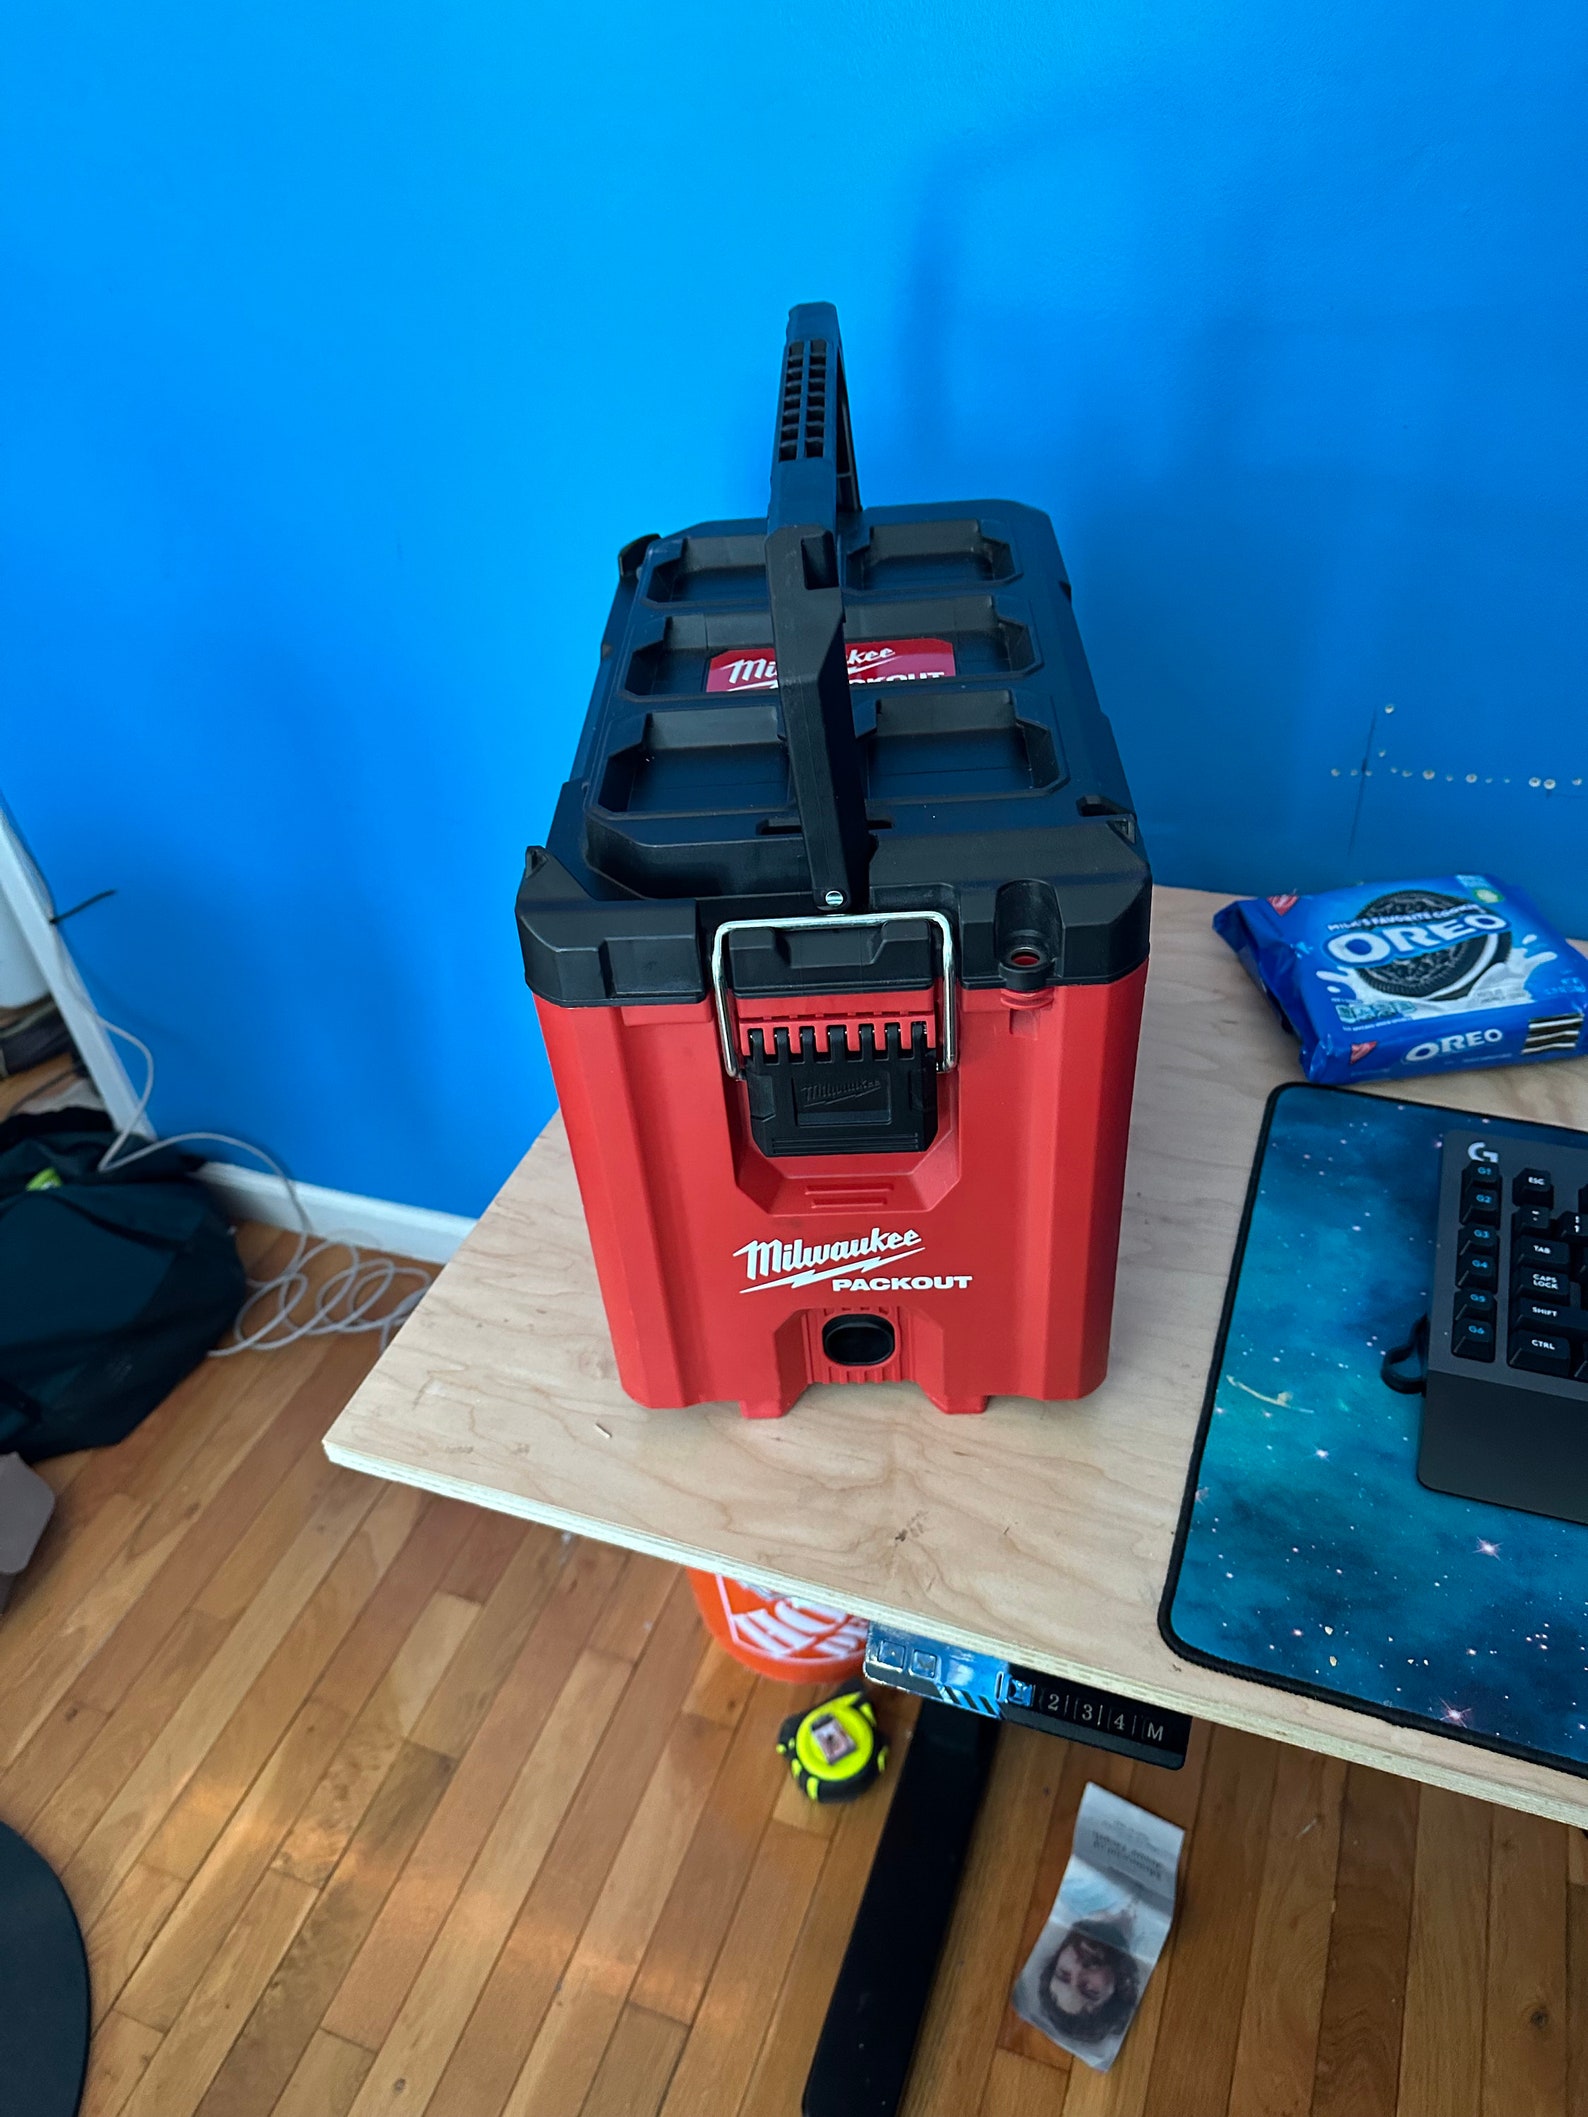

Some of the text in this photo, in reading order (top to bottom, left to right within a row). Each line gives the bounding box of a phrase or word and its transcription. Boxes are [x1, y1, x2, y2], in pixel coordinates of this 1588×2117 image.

[720, 648, 896, 684] Mikee
[1327, 914, 1506, 963] OREO
[1405, 1028, 1503, 1062] OREO
[1477, 1166, 1492, 1176] G1
[1528, 1176, 1545, 1186] ESC
[1475, 1194, 1492, 1204] G2
[1473, 1229, 1490, 1239] G3
[733, 1228, 923, 1281] Milwaukee
[1533, 1244, 1551, 1255] TAB
[1472, 1259, 1488, 1269] G4
[1532, 1273, 1557, 1283] CAPS
[832, 1275, 973, 1292] PACKOUT
[1533, 1280, 1559, 1290] LOCK
[1470, 1293, 1486, 1303] G5
[1532, 1306, 1558, 1317] SHIFT
[1468, 1325, 1485, 1335] G6
[1531, 1339, 1556, 1351] CTRL
[1047, 1693, 1164, 1742] 2 3 4 M
